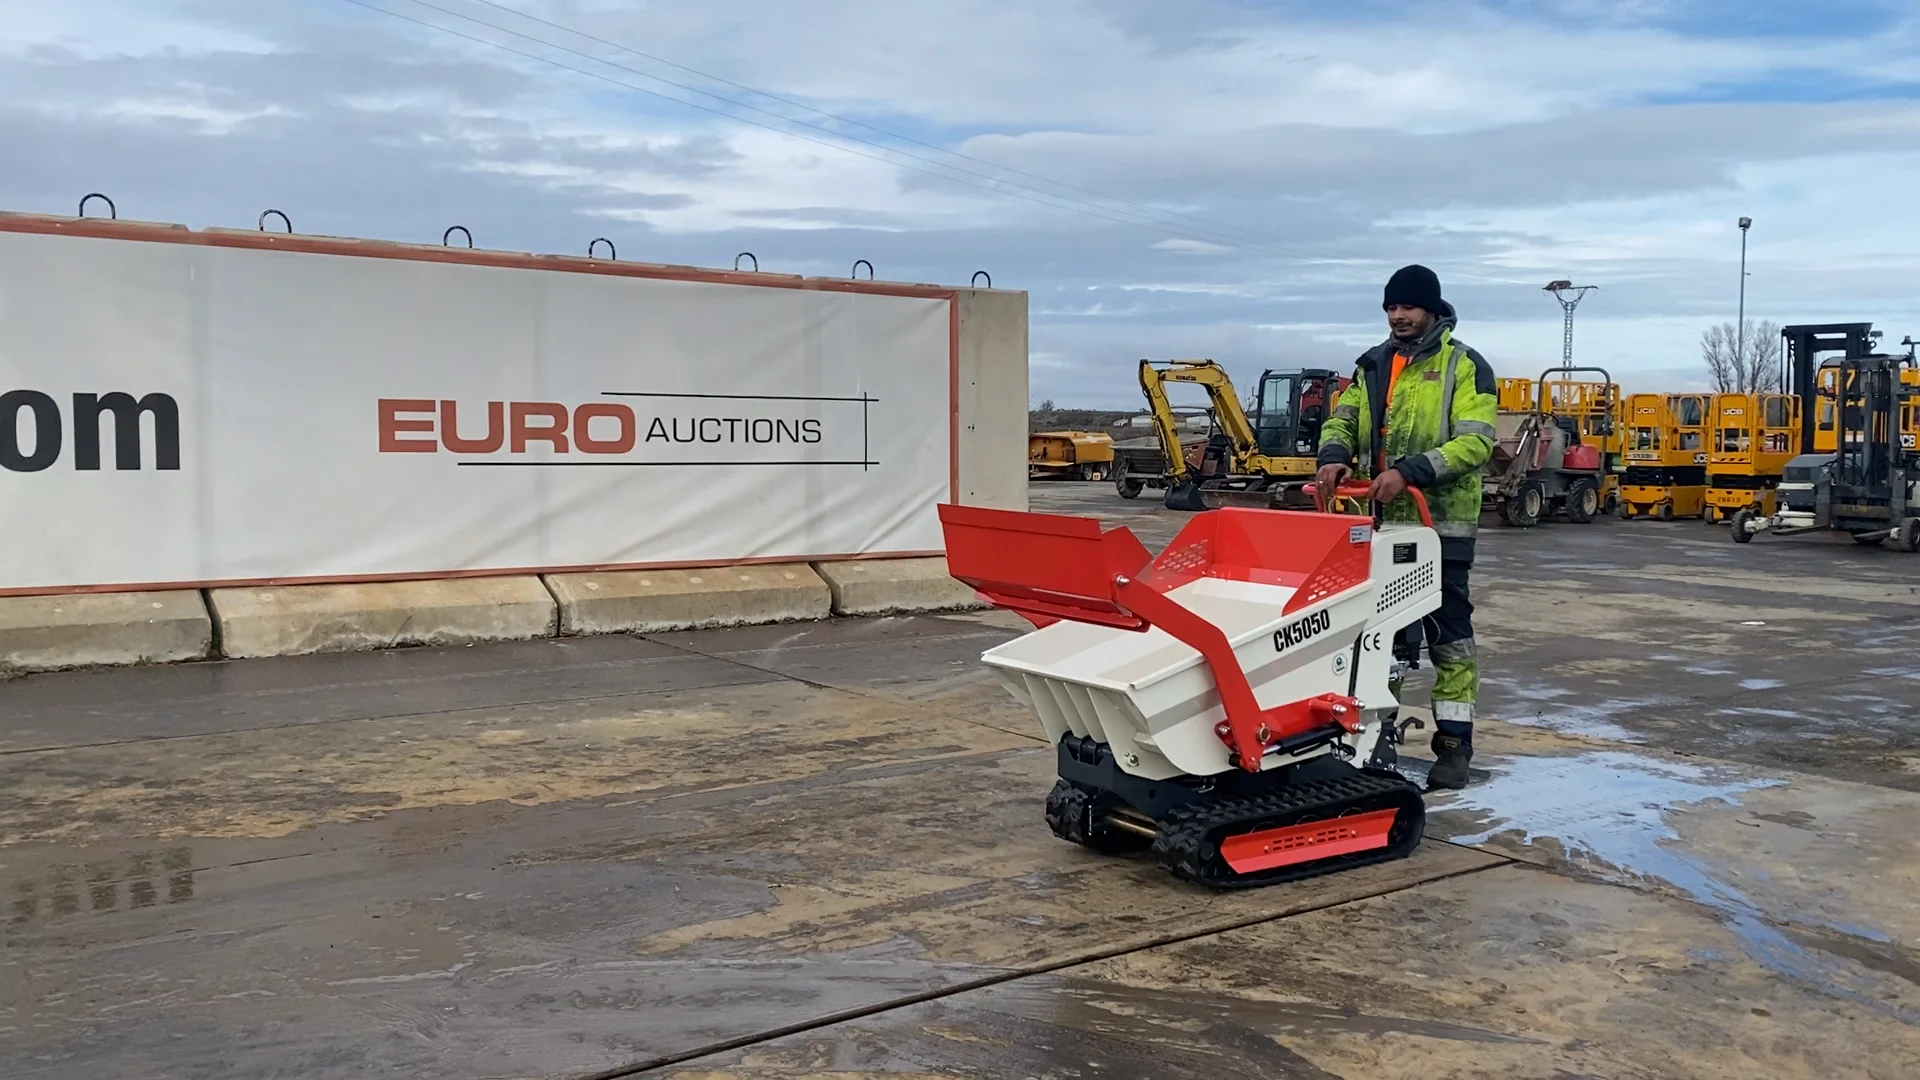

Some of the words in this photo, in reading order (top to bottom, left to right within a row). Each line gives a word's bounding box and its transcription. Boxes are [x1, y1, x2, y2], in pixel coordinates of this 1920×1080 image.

[378, 398, 636, 453] EURO
[645, 416, 823, 443] AUCTIONS
[1273, 608, 1331, 653] CK5050
[1363, 632, 1381, 651] CE
